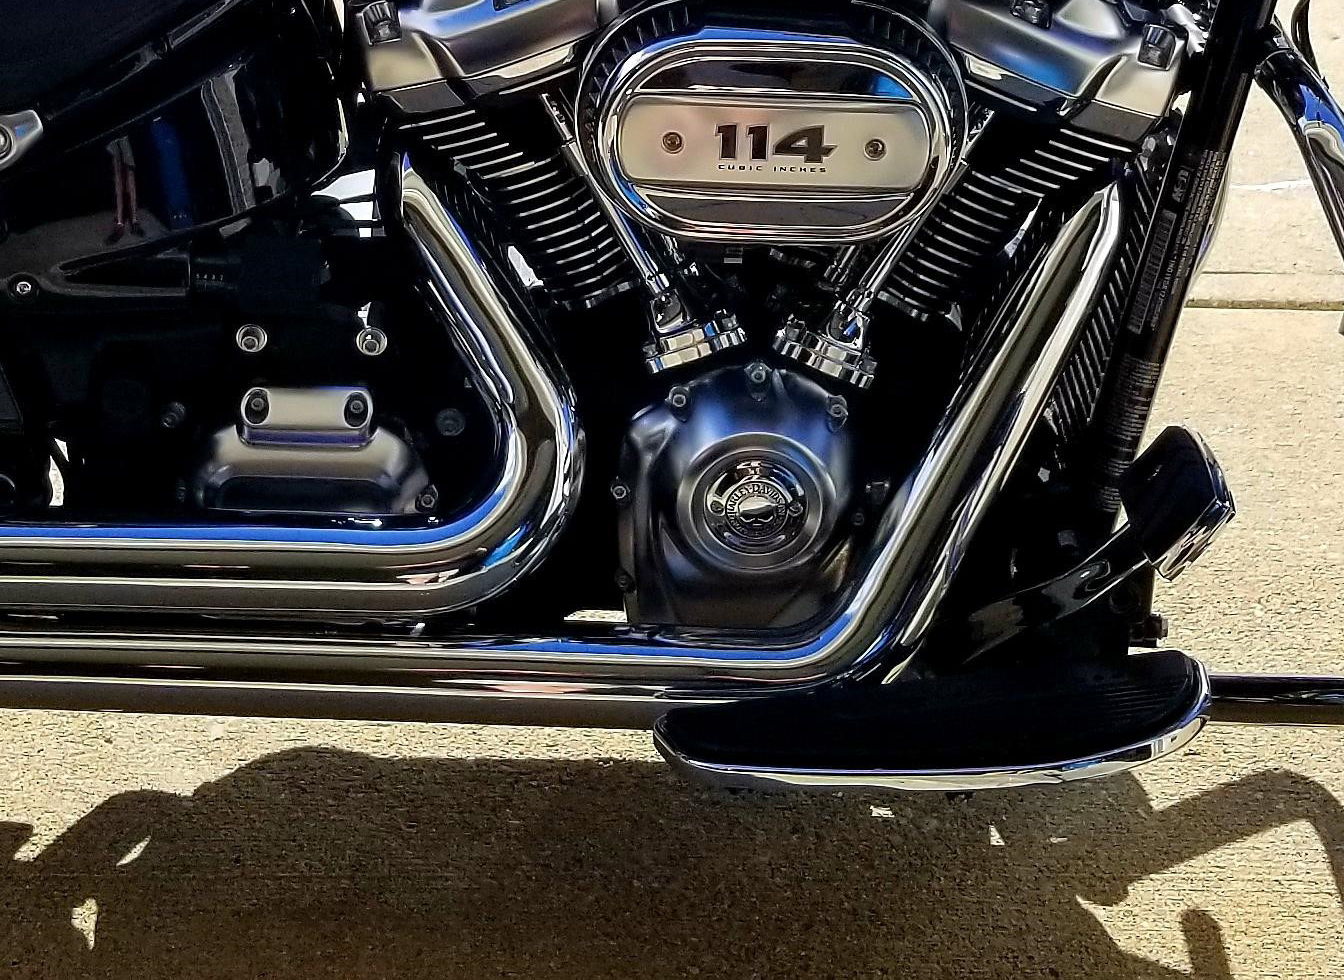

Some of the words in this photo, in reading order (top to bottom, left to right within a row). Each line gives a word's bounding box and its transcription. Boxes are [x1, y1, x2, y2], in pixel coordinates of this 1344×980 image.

[715, 122, 837, 163] 114
[717, 163, 763, 172] CUBIC
[773, 165, 827, 173] INCHES
